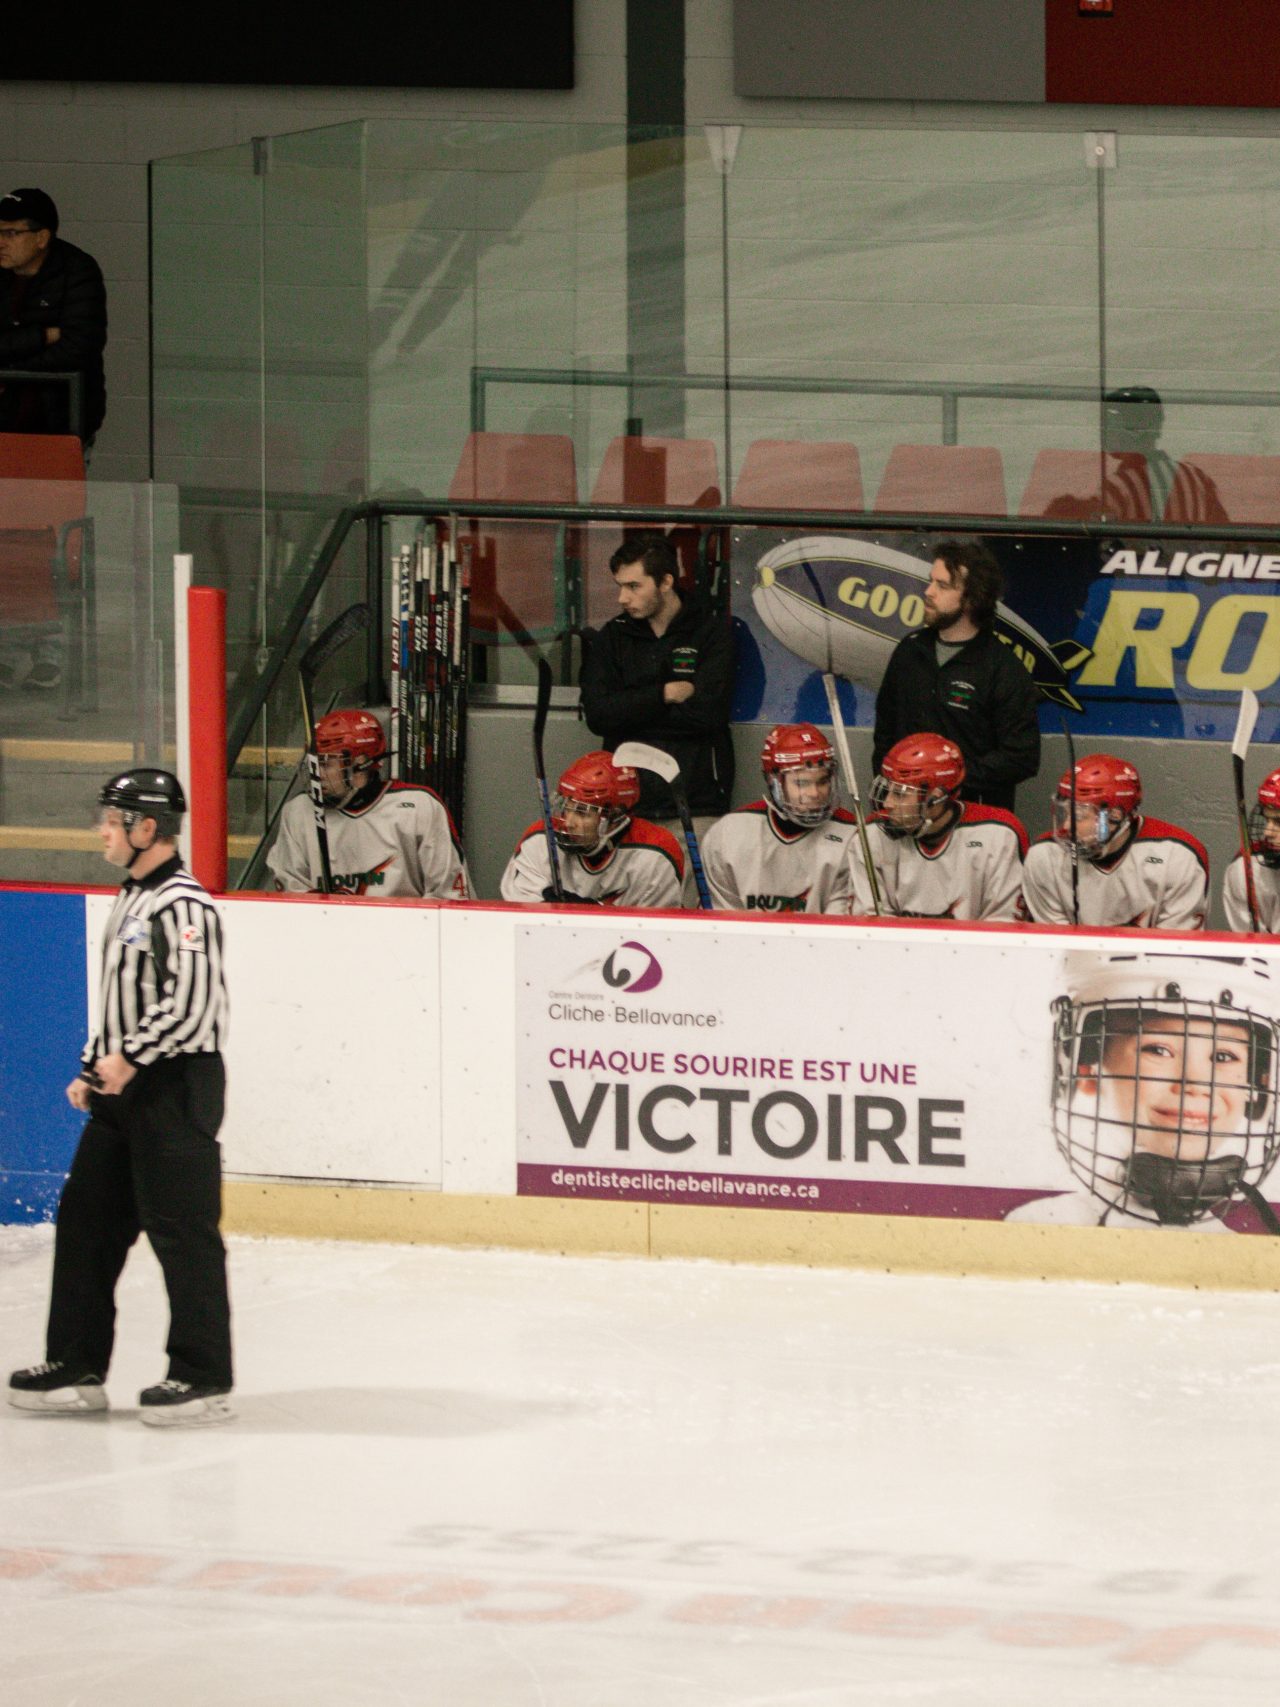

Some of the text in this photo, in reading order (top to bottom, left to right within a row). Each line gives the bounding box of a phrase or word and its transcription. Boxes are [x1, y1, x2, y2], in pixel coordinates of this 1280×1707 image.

[307, 752, 326, 831] CCM
[548, 1003, 718, 1028] Cliche Bellavance
[548, 1048, 918, 1085] CHAQUE SOURIRE EST UNE
[548, 1079, 967, 1168] VICTOIRE
[551, 1169, 820, 1199] dentisteclichebellavance.ca
